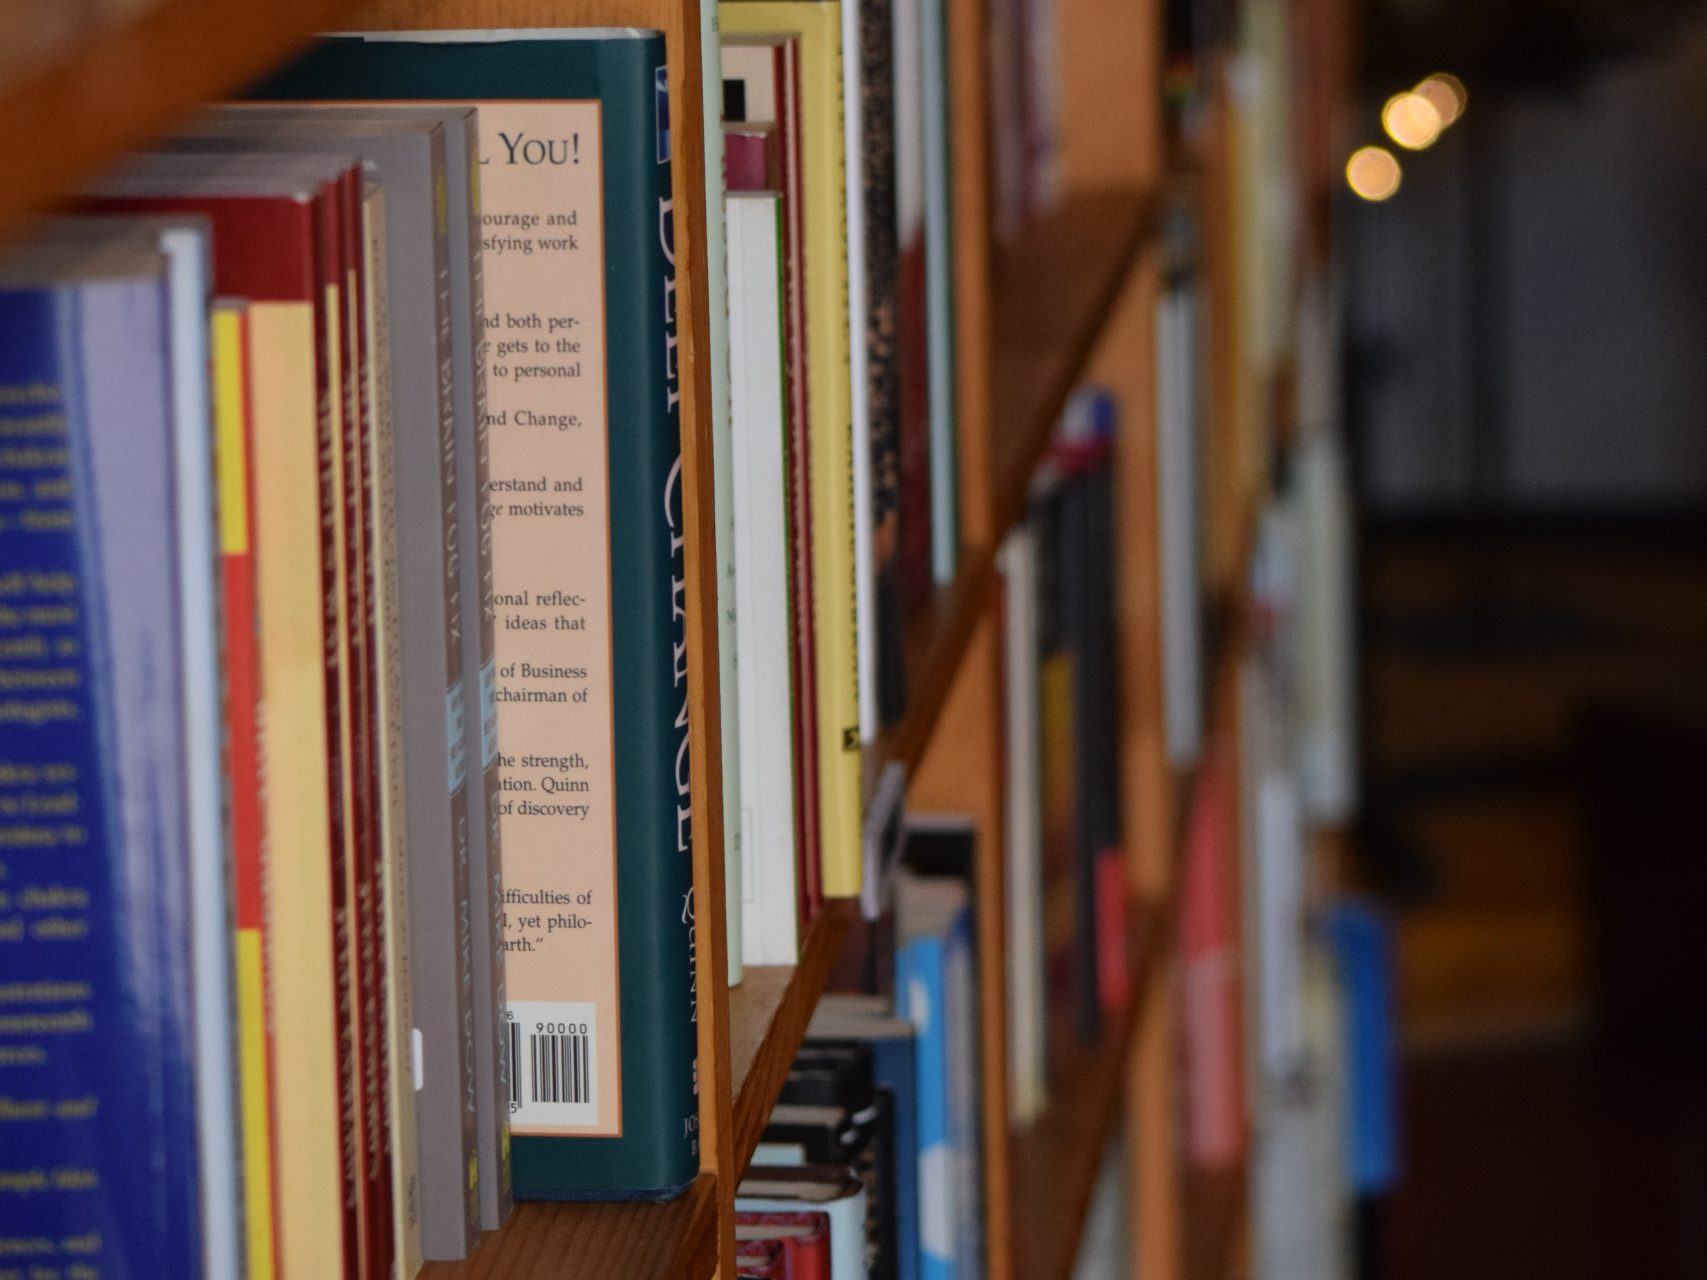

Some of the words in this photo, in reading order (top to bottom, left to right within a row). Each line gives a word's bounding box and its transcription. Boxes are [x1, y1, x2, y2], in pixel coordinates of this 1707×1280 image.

[498, 132, 580, 165] YOU!
[481, 210, 540, 231] ourage
[546, 210, 578, 227] and
[481, 233, 533, 255] sfying
[537, 234, 579, 251] work
[506, 313, 542, 330] both
[549, 317, 581, 334] per-
[496, 336, 529, 358] gets
[535, 338, 550, 353] to
[556, 336, 582, 353] the
[493, 363, 509, 378] to
[514, 362, 582, 383] personal
[486, 410, 507, 426] nd
[513, 409, 583, 432] Change,
[489, 476, 548, 493] erstand
[553, 476, 584, 493] and
[508, 501, 585, 517] motivates
[493, 591, 529, 607] onal
[535, 591, 587, 608] reflec-
[505, 615, 548, 631] ideas
[553, 616, 587, 631] that
[499, 662, 516, 678] of
[521, 663, 588, 679] Business
[495, 687, 568, 703] chairman
[572, 687, 589, 704] of
[498, 751, 516, 768] he
[521, 751, 590, 773] strength,
[498, 777, 537, 793] tion.
[540, 776, 590, 794] Quinn
[499, 800, 514, 817] of
[517, 800, 591, 822] discovery
[501, 889, 571, 906] ifficulties
[576, 889, 593, 906] of
[518, 913, 542, 933] yet
[547, 912, 593, 934] philo-
[501, 937, 544, 953] arth.”
[536, 1022, 588, 1035] 90000
